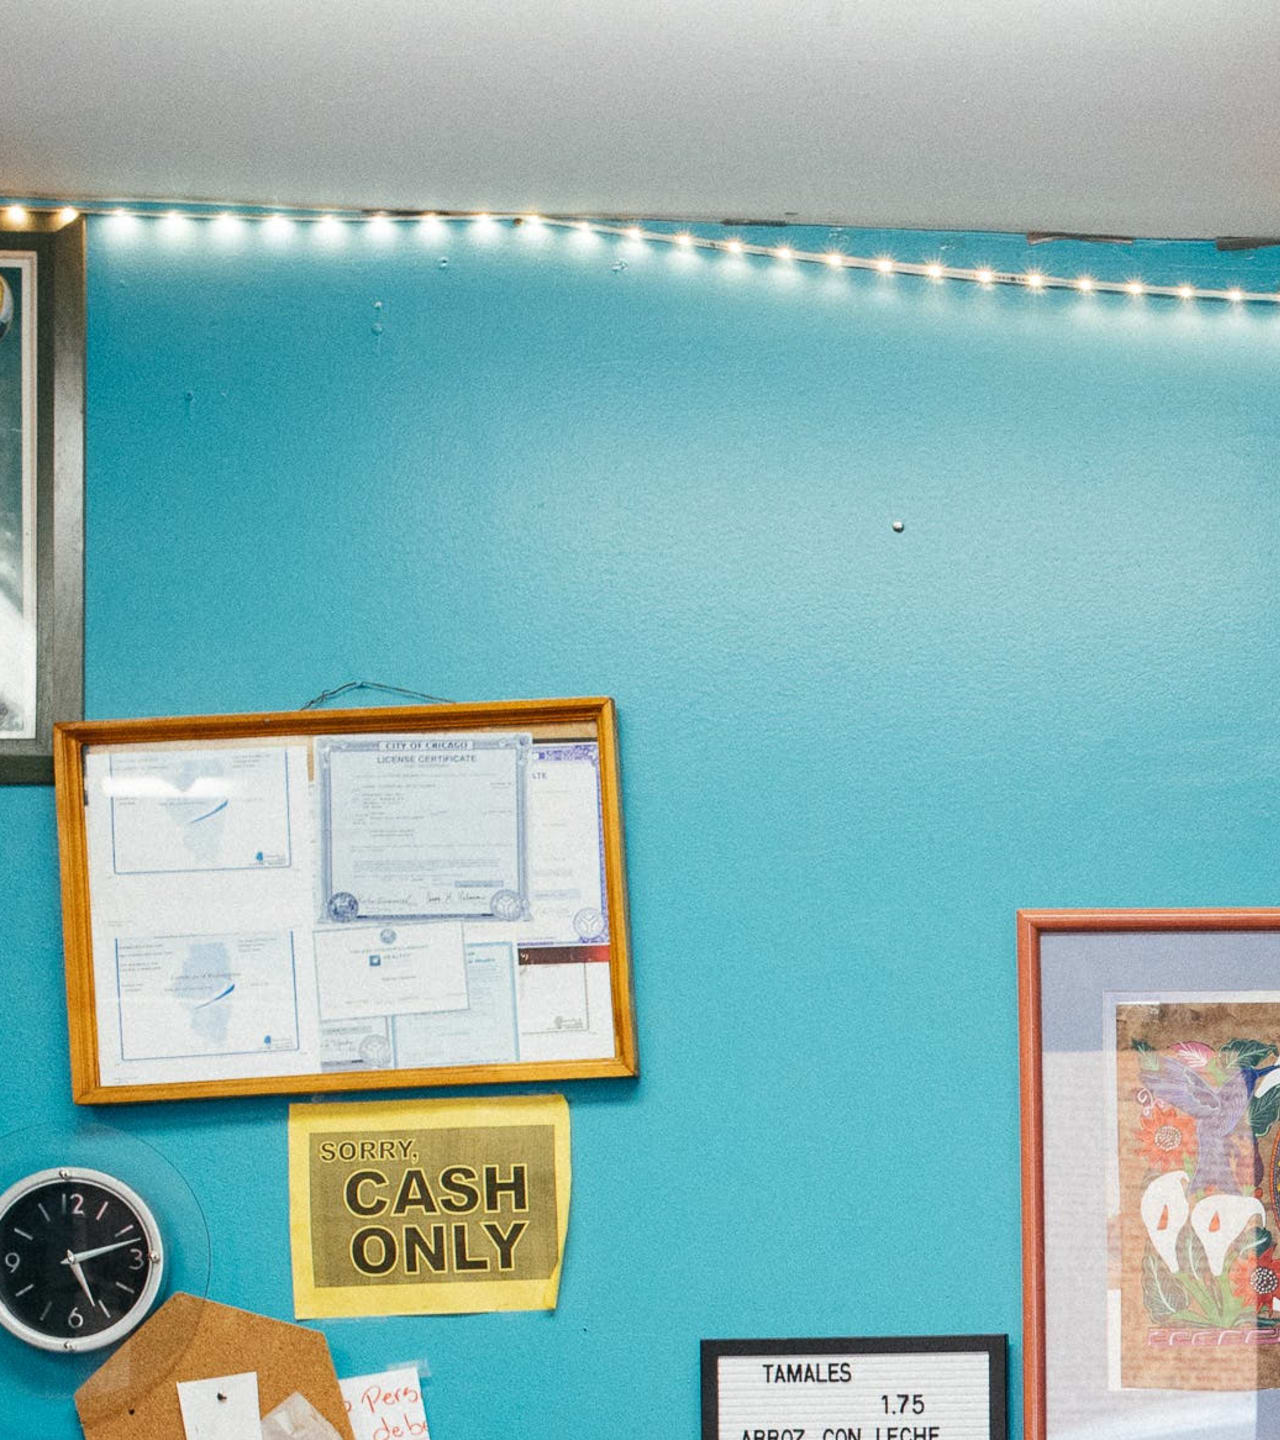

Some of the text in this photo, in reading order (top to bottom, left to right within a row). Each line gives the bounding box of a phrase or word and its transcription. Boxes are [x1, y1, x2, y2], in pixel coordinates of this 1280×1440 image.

[320, 1140, 419, 1162] SORRY,
[344, 1163, 529, 1218] CASH
[62, 1193, 85, 1216] 12
[350, 1220, 529, 1277] ONLY
[5, 1252, 21, 1273] 9
[129, 1249, 144, 1270] 3
[68, 1307, 84, 1328] 6
[763, 1363, 851, 1384] TAMALES
[881, 1394, 925, 1414] 1.75
